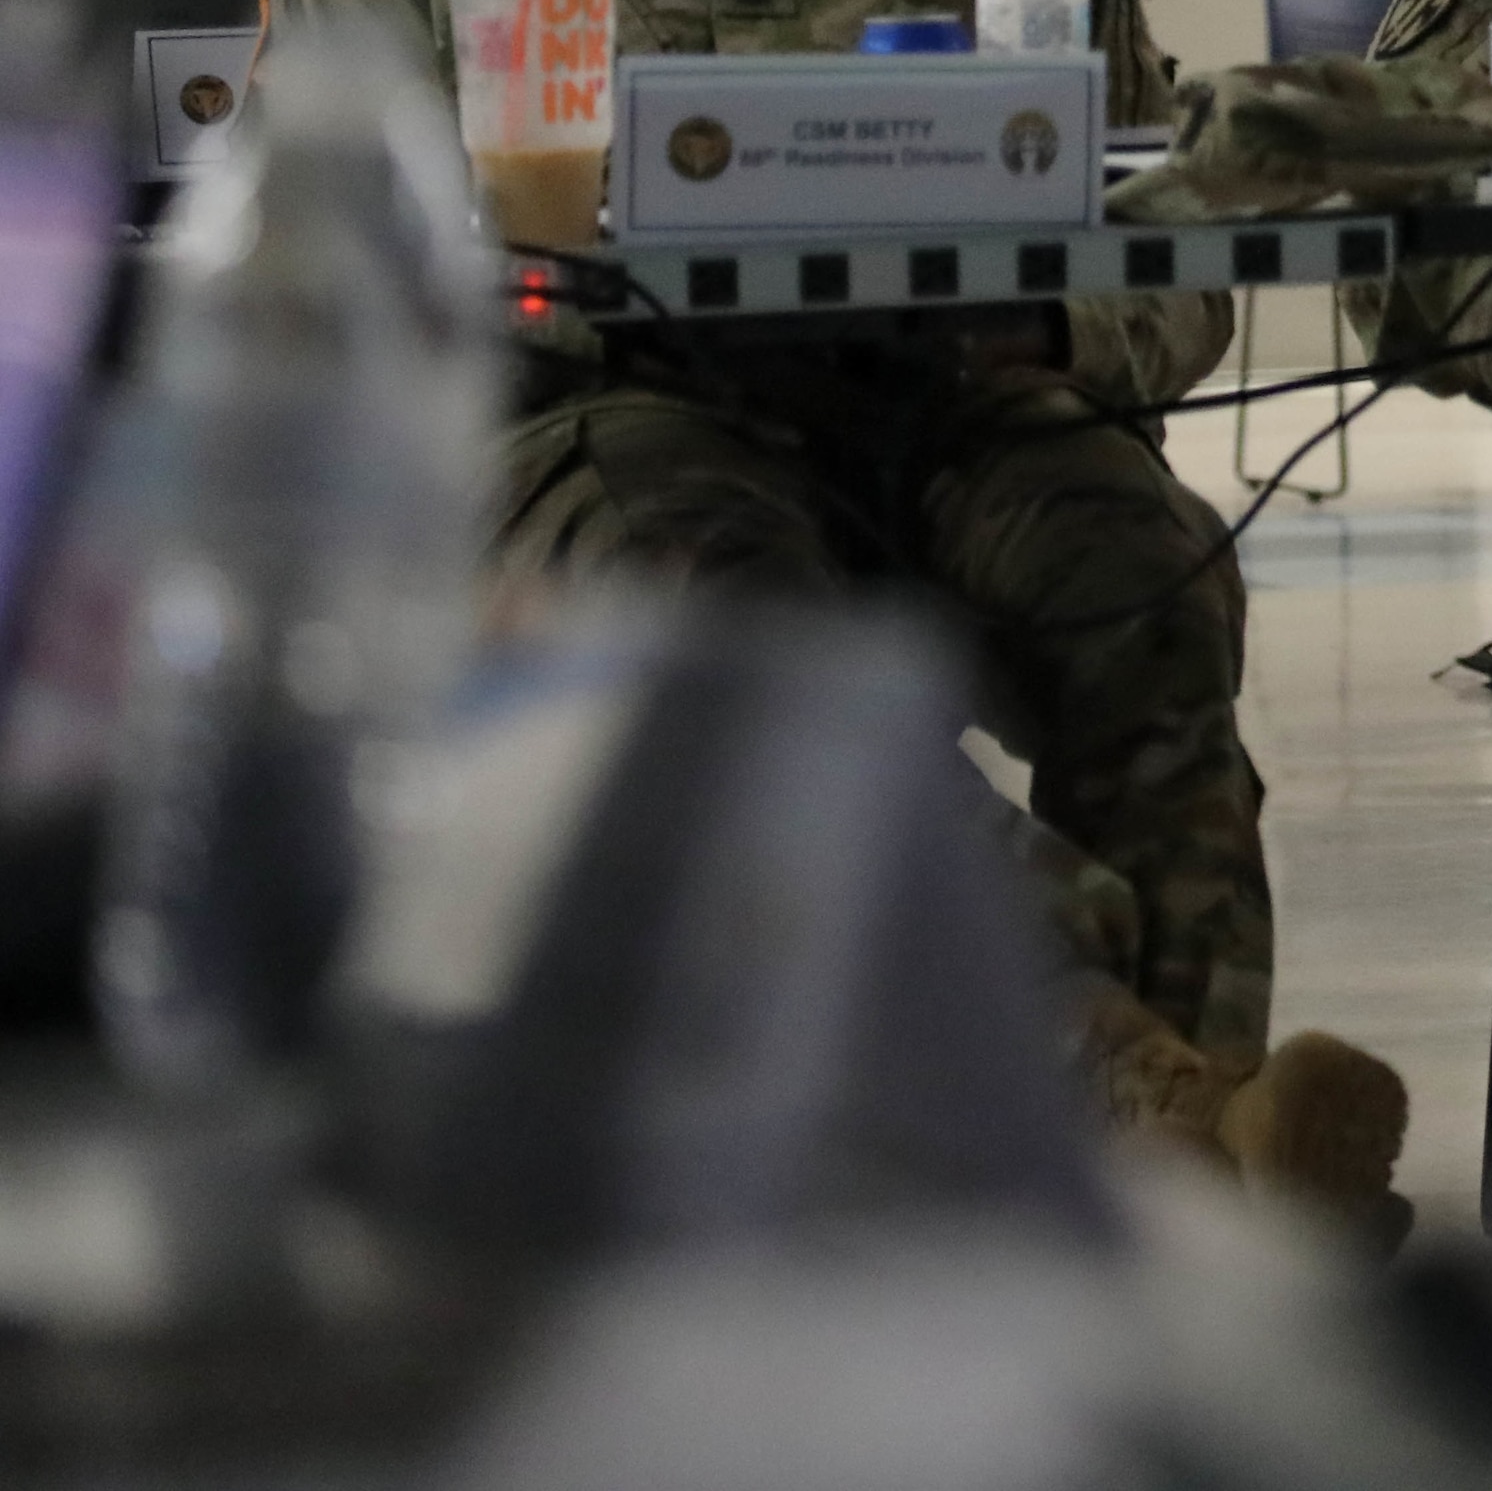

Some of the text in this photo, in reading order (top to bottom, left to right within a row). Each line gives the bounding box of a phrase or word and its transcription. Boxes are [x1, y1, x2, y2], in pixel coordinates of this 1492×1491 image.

[793, 118, 935, 141] CSM BETTY
[784, 146, 895, 166] Readiness
[900, 146, 987, 166] Division
